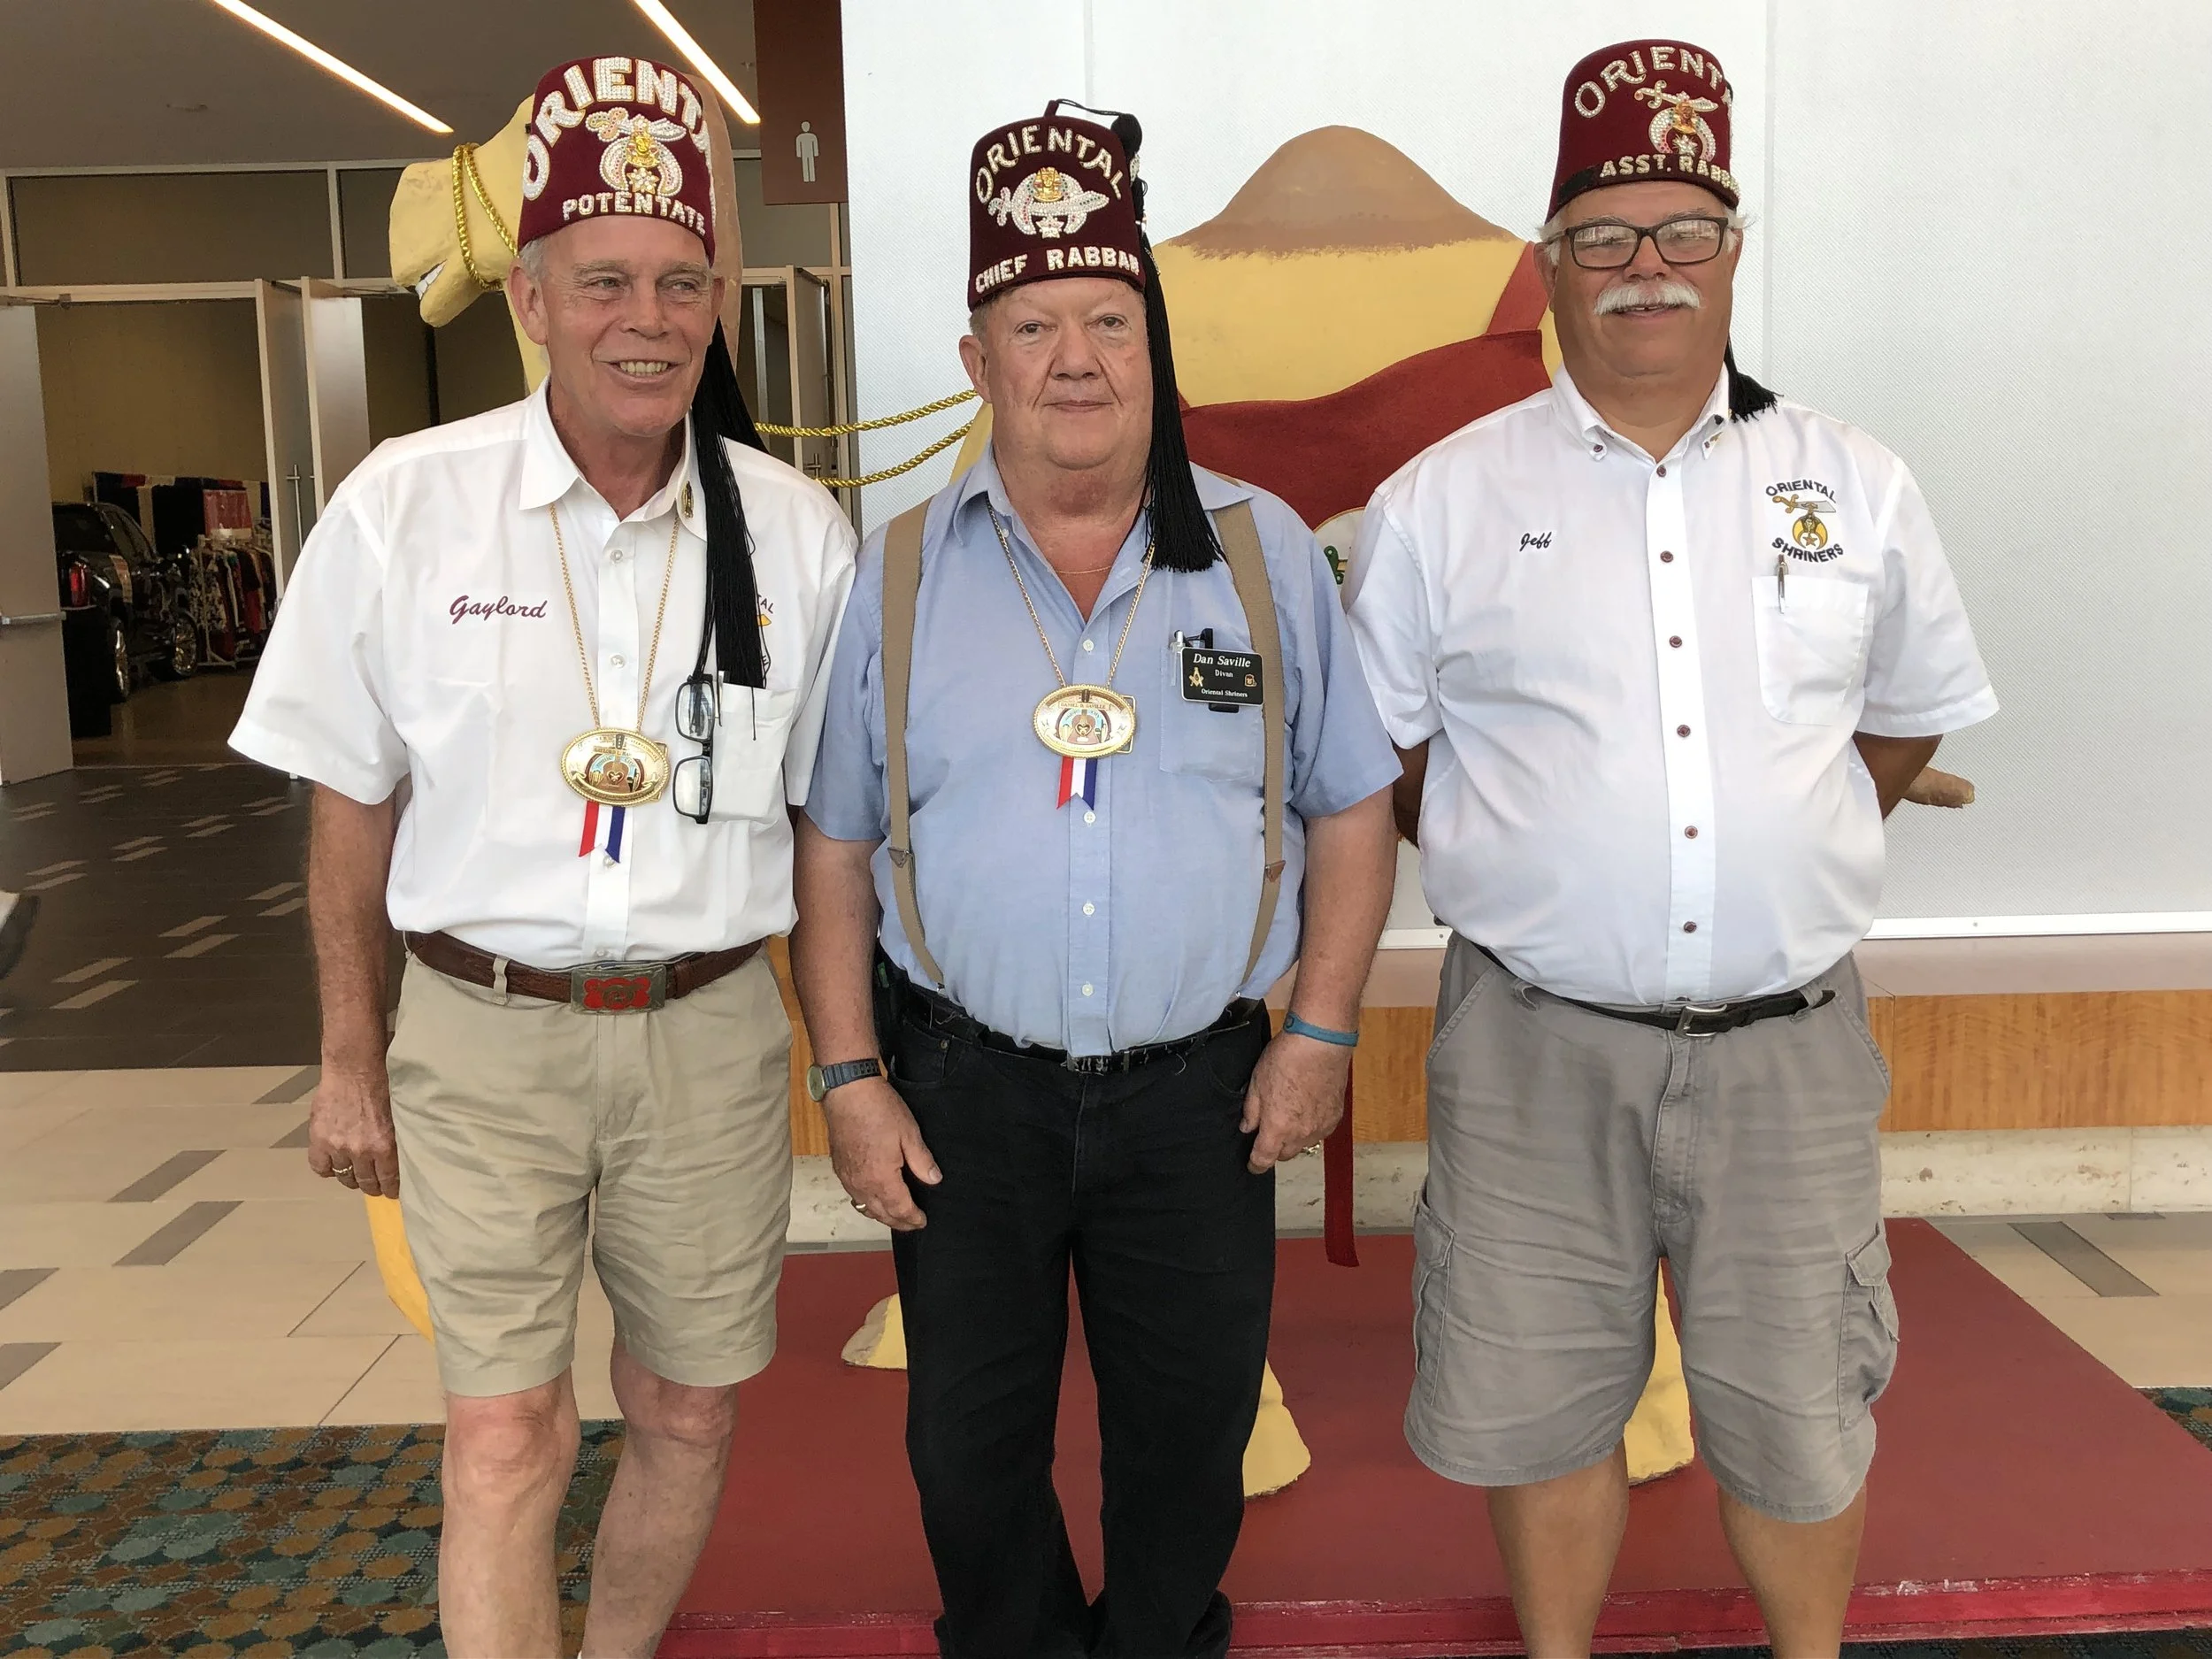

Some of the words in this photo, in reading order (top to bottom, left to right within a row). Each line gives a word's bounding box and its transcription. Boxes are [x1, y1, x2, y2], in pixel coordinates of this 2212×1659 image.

[975, 124, 1124, 204] ORIENTAL
[562, 191, 706, 236] POTENTATE
[975, 253, 1028, 294] CHIEF
[1046, 246, 1140, 276] RABBAN
[1765, 479, 1837, 503] ORIENTAL
[1519, 531, 1553, 552] Jeff
[1771, 537, 1844, 563] SHRINERS
[449, 595, 548, 625] Gaylord
[1193, 654, 1214, 664] Dan
[1217, 656, 1251, 667] Saville
[1215, 669, 1233, 678] Divan
[1201, 687, 1224, 696] Oriental
[1225, 689, 1248, 698] Shriners
